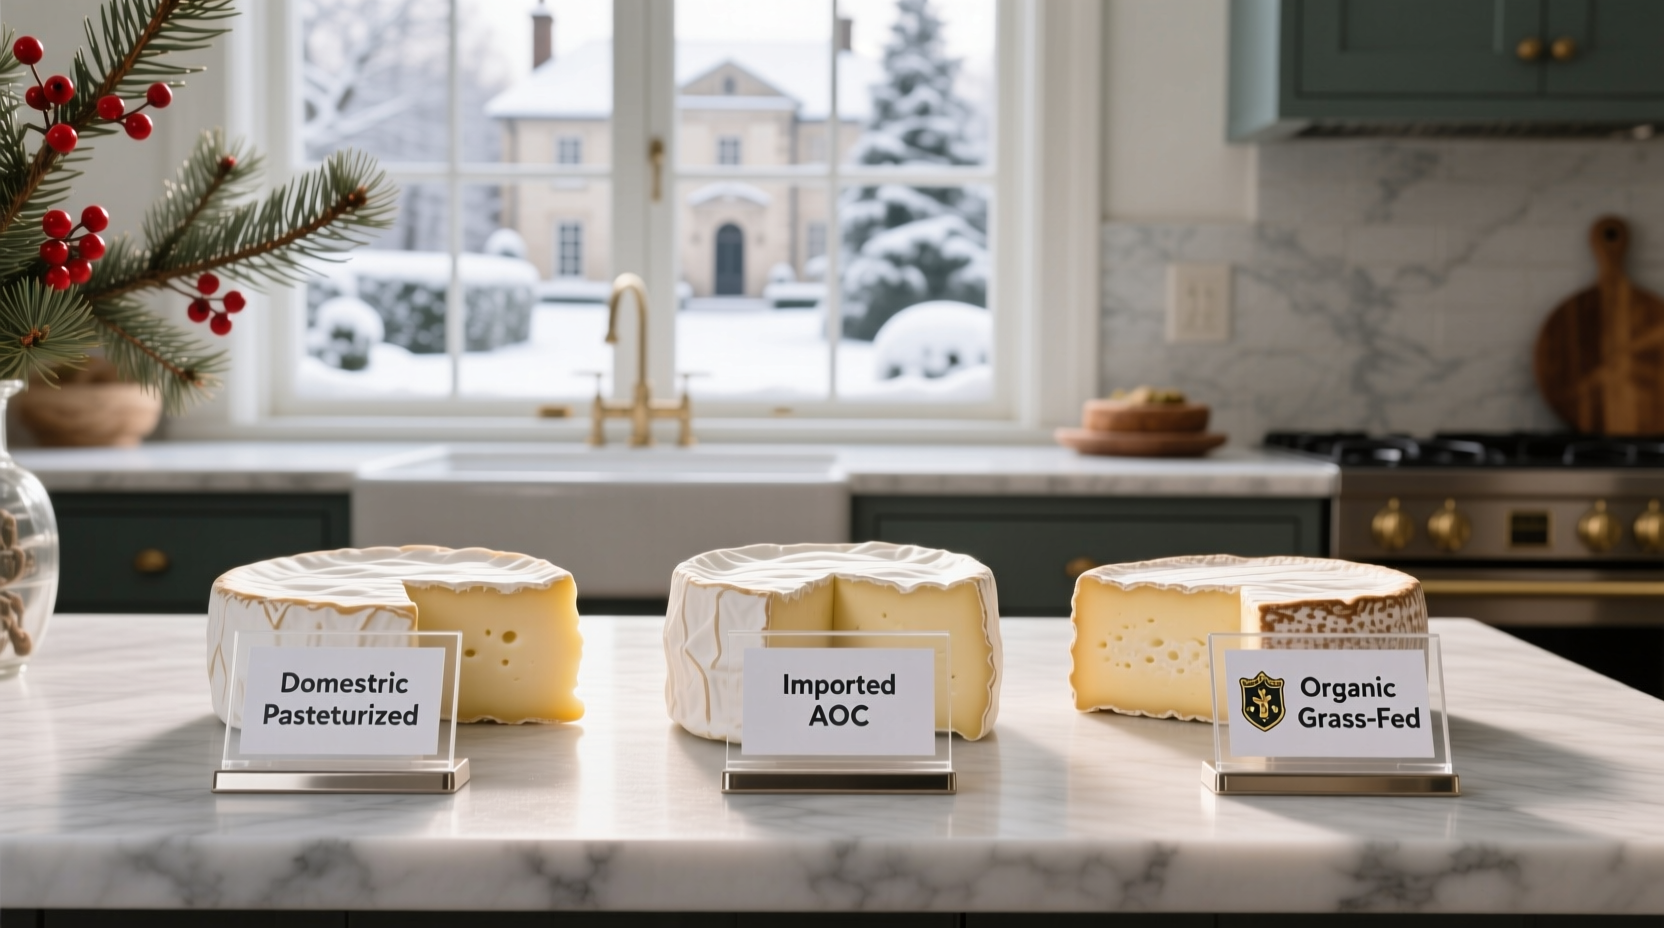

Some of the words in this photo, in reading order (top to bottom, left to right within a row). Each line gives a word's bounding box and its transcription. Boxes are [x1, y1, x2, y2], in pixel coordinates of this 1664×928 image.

[280, 671, 409, 694] Domestric
[783, 673, 896, 701] Imported
[1300, 676, 1397, 704] Organic
[263, 703, 419, 726] Pasteturized
[808, 704, 870, 727] AOC
[1298, 706, 1421, 729] Grass-Fed
